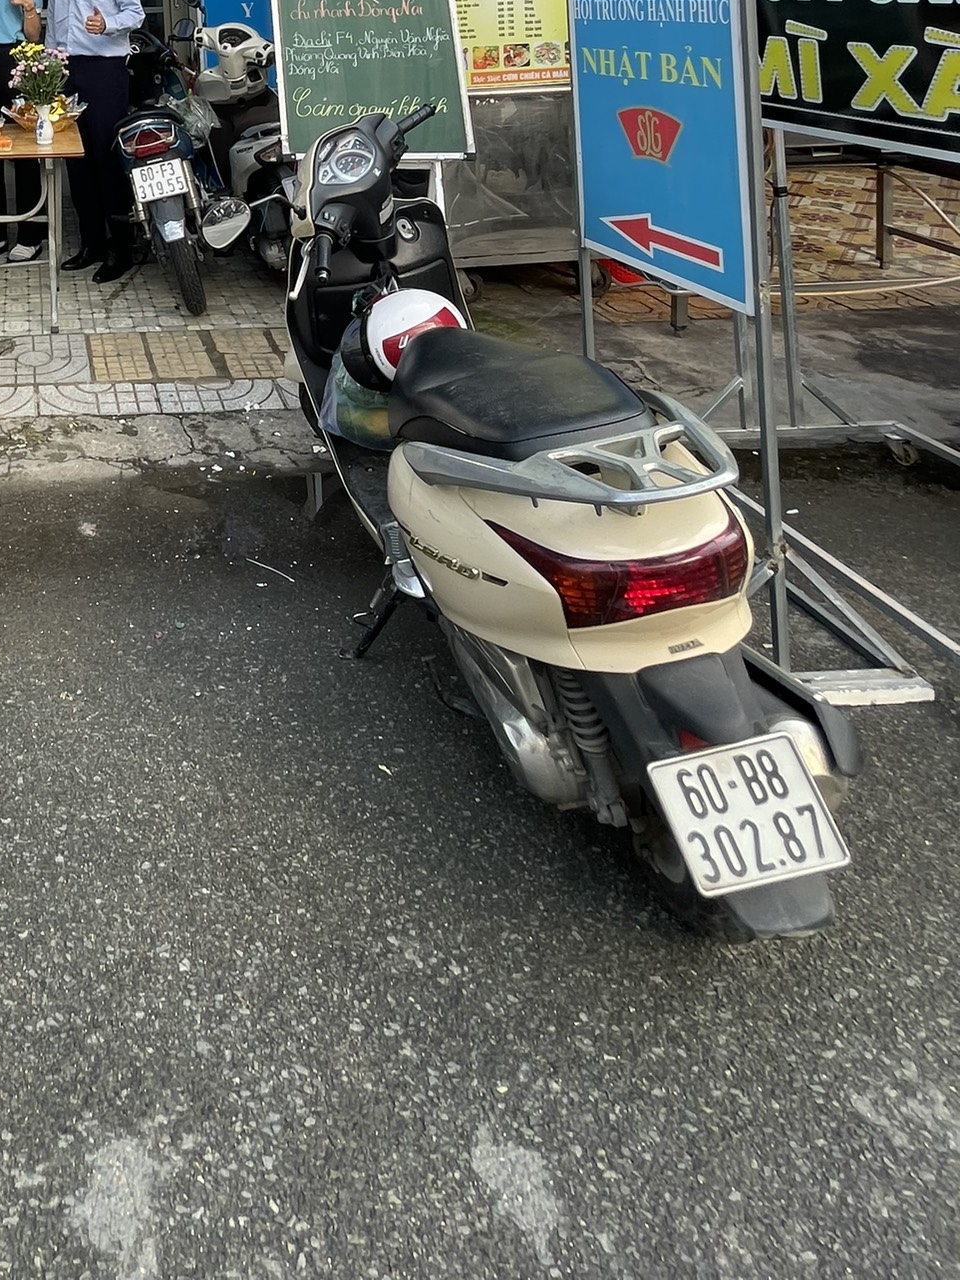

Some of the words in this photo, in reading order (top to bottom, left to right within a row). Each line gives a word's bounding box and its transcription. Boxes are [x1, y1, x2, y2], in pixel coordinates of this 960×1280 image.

[241, 2, 254, 18] Y
[647, 0, 685, 28] HẠNH
[582, 45, 652, 86] NHẬT
[658, 45, 722, 90] BẢN
[140, 163, 176, 183] 60-F3
[139, 175, 185, 200] 319.55
[675, 750, 789, 820] 60-B8
[686, 803, 826, 883] 302.87
